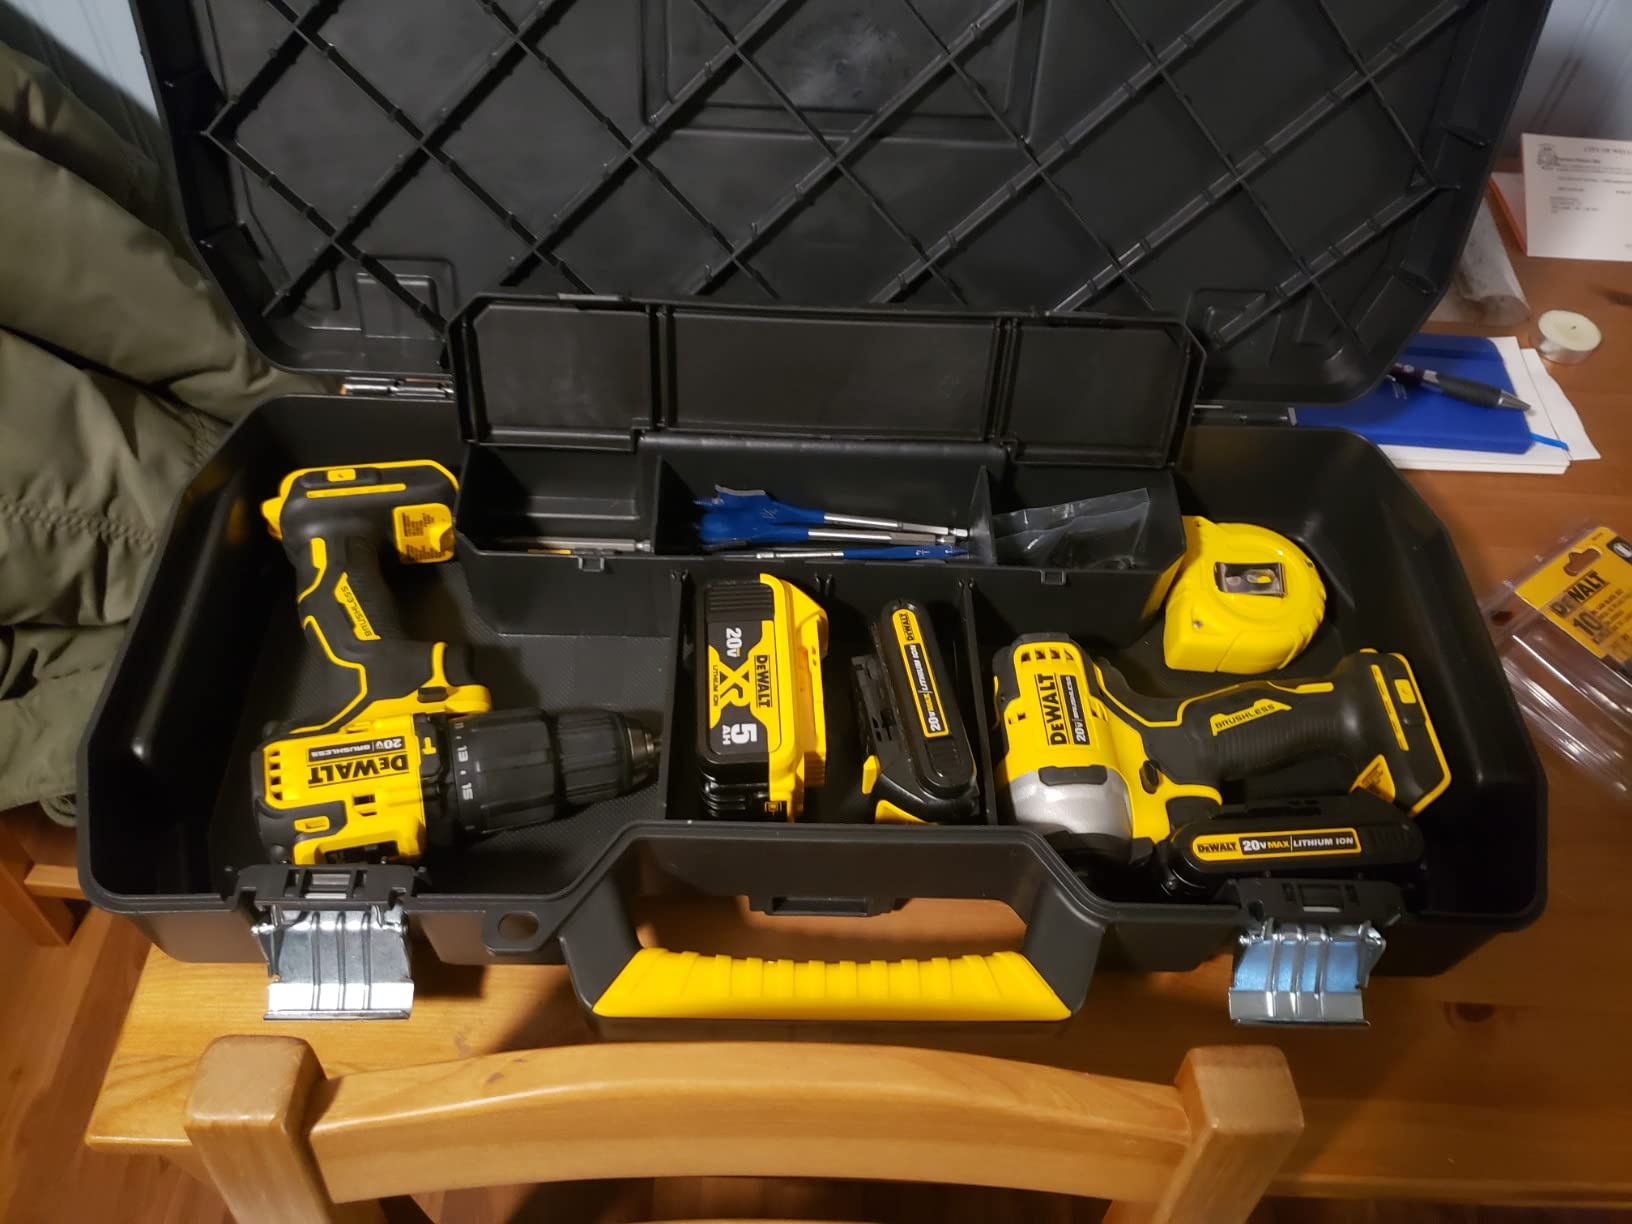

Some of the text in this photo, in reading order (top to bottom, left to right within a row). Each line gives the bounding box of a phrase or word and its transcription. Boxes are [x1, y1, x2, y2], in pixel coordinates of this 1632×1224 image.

[340, 585, 373, 637] BRUSHLESS
[756, 654, 771, 708] DEWALT
[1037, 673, 1067, 745] DEWALT
[1215, 703, 1275, 729] BRUSHLESS
[730, 723, 758, 744] 5
[307, 754, 410, 785] DEWALT
[1293, 838, 1333, 848] LITHIUM
[1336, 837, 1354, 845] ION
